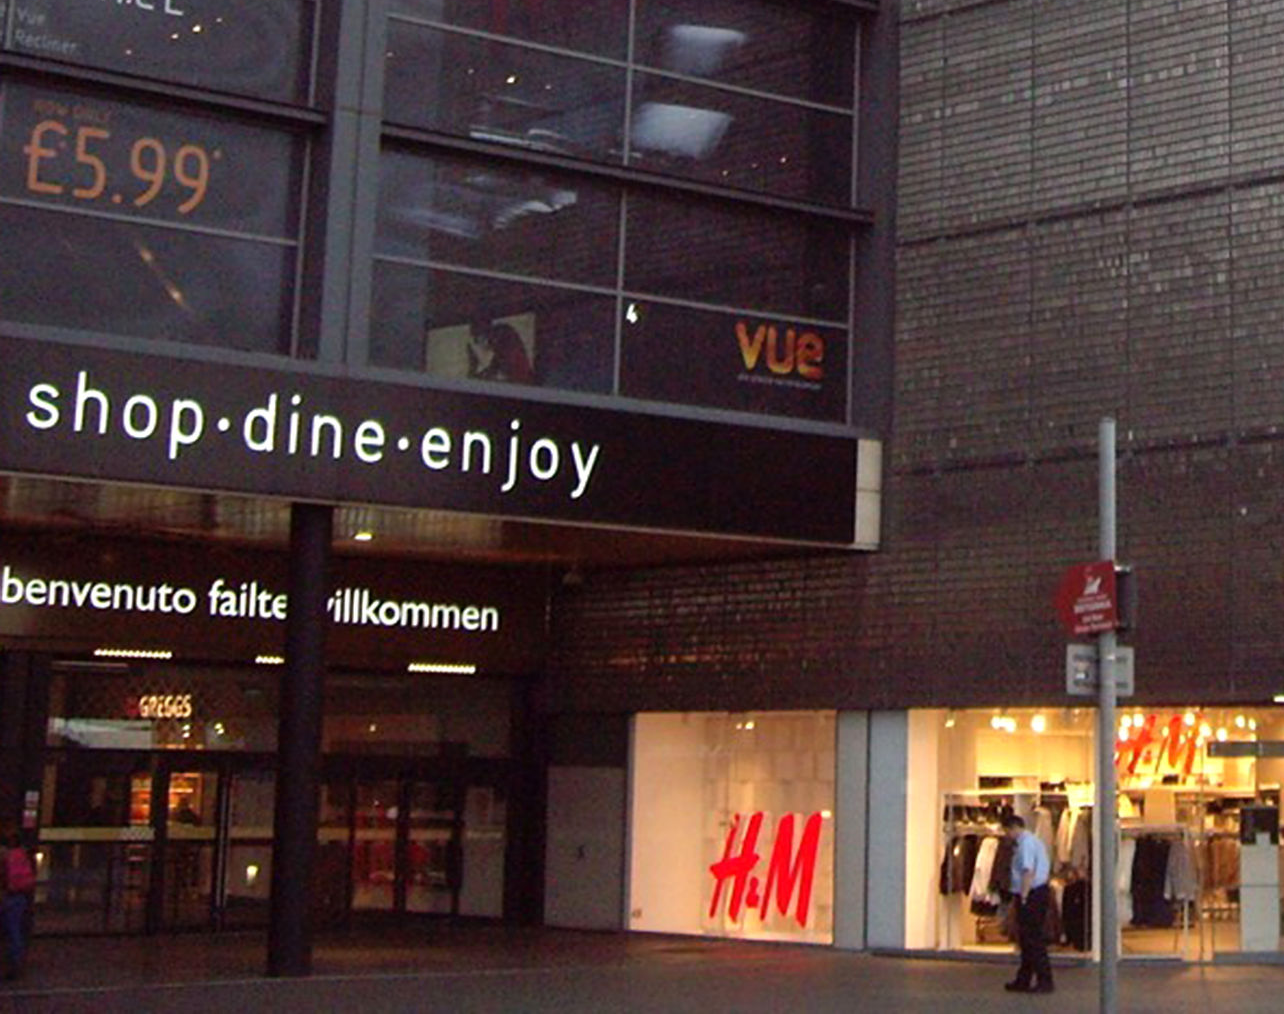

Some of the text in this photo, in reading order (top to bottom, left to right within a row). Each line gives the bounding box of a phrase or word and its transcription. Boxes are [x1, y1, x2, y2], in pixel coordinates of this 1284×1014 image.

[1, 565, 198, 614] benvenuto
[327, 588, 498, 631] illkommen
[709, 811, 822, 927] H&M
